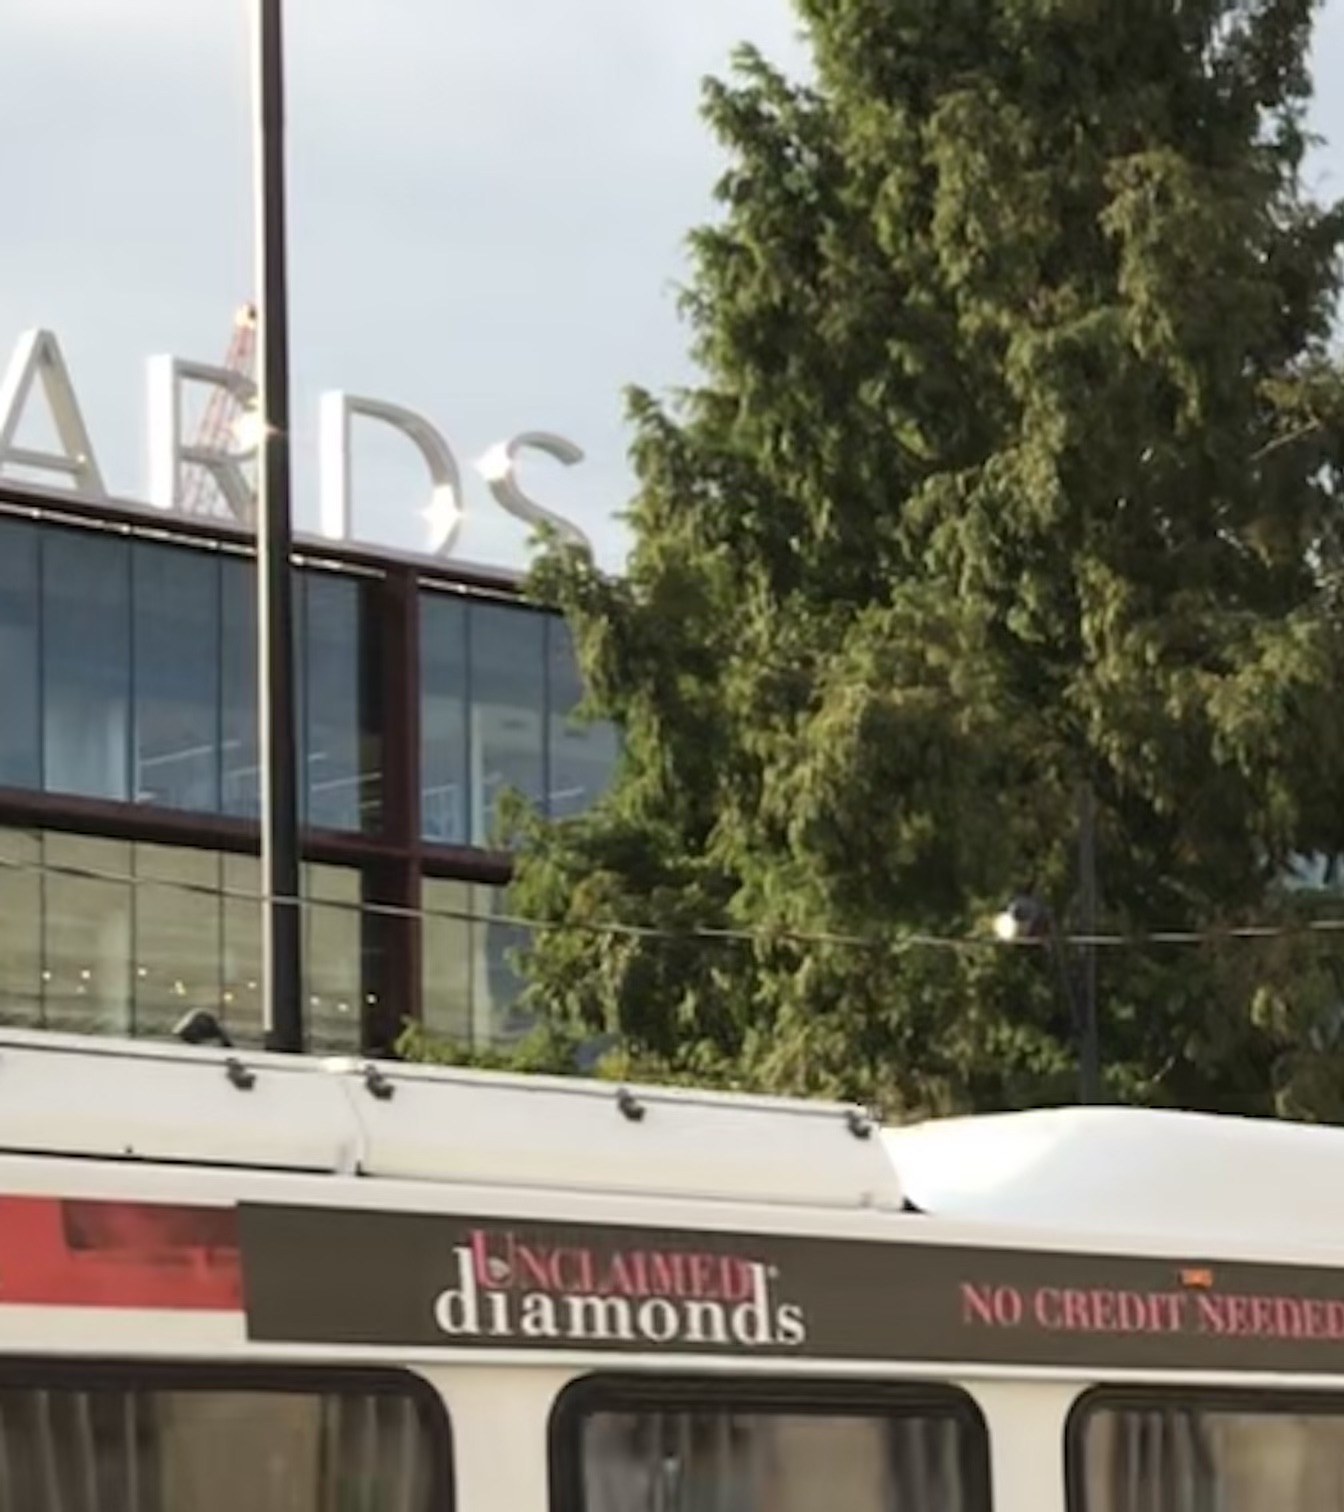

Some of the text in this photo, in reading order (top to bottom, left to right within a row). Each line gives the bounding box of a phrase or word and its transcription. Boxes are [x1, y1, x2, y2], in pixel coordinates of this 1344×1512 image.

[434, 1247, 807, 1345] diamonds
[961, 1281, 1022, 1326] NO
[1034, 1286, 1184, 1333] CREDIT
